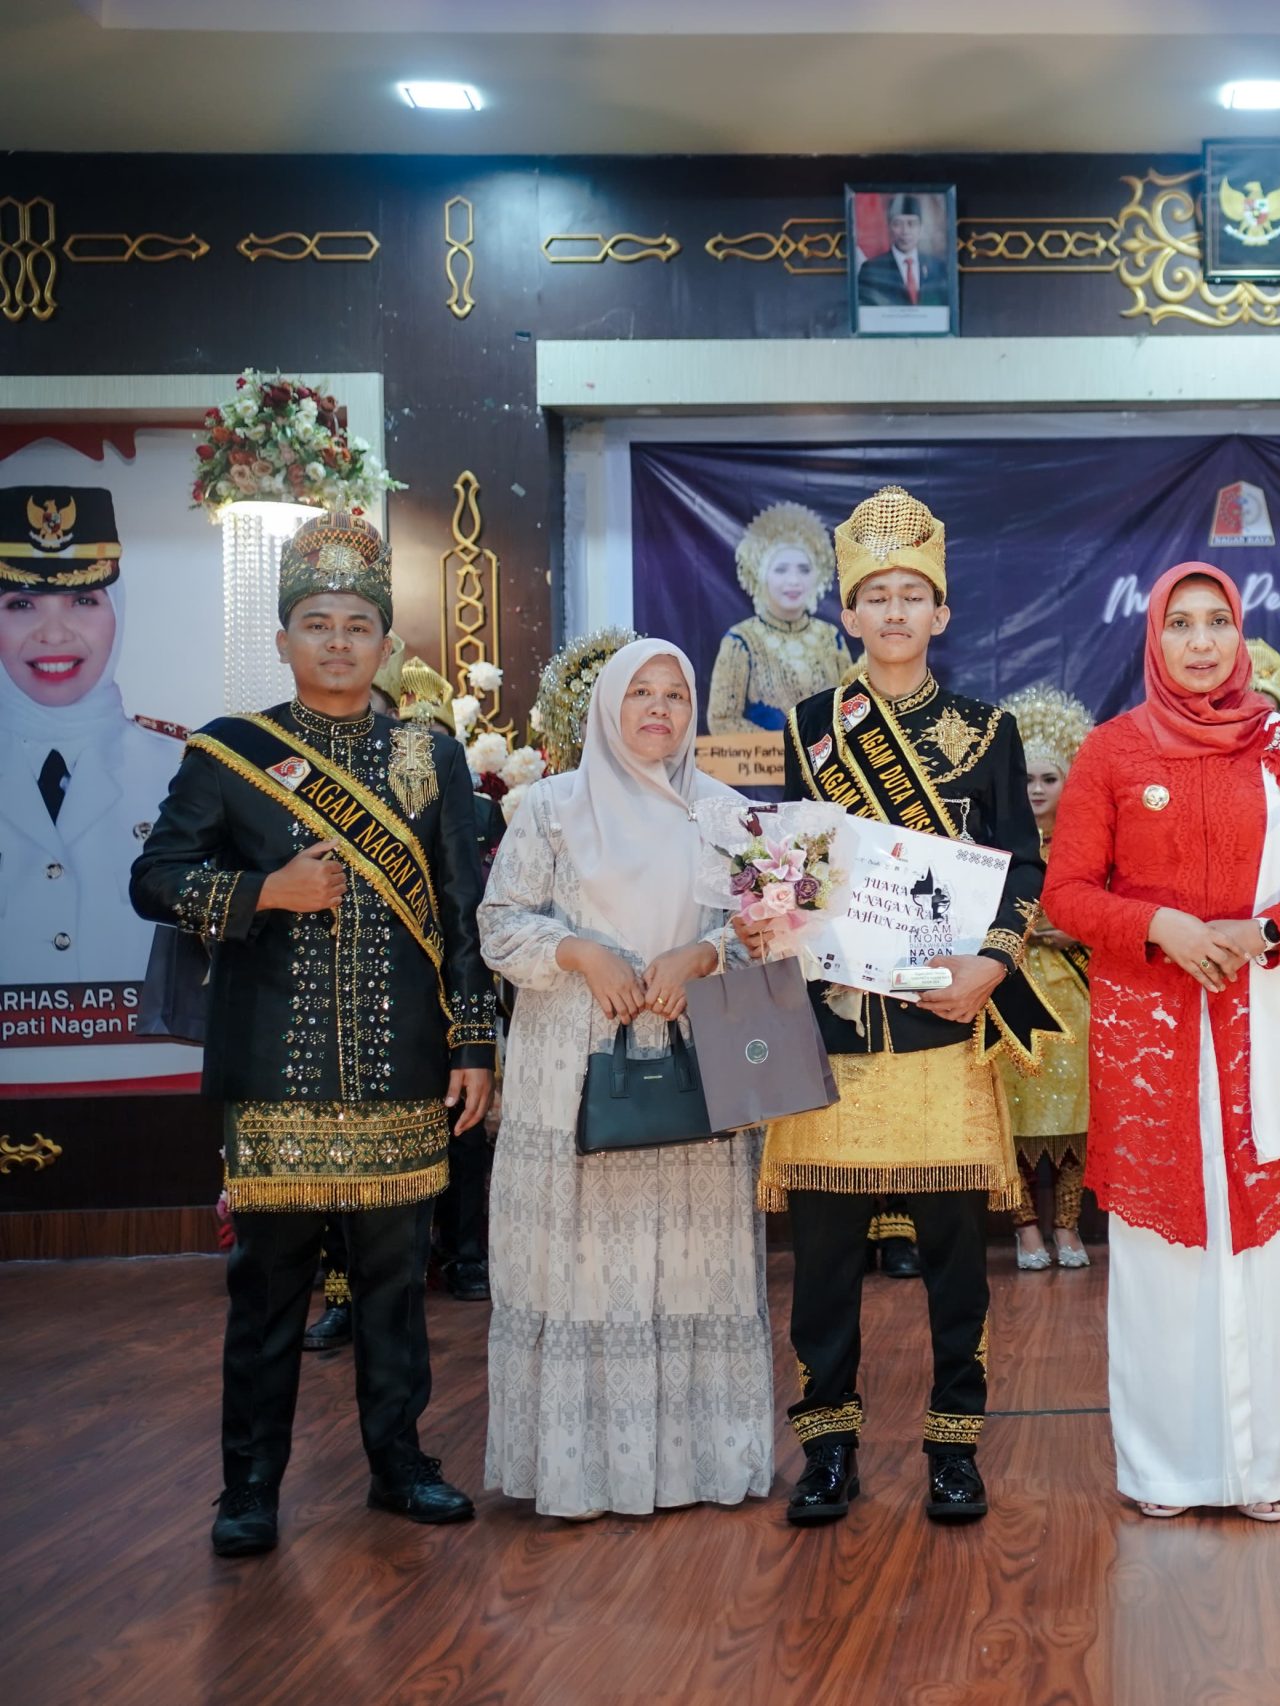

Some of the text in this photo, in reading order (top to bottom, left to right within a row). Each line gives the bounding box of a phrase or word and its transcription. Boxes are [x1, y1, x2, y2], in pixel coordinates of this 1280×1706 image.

[857, 727, 896, 769] AGAM
[879, 764, 915, 806] DUTA
[819, 764, 861, 808] AGAM
[301, 776, 367, 832] AGAM
[353, 819, 417, 888] NAGAN
[864, 876, 908, 897] JUARA
[864, 893, 911, 916] NAGAN
[847, 907, 894, 929] TAHUN
[909, 933, 953, 943] INONG
[909, 948, 953, 957] NAGAN
[0, 988, 75, 1012] RHAS,
[81, 988, 116, 1012] AP,
[51, 1015, 122, 1039] Nagan
